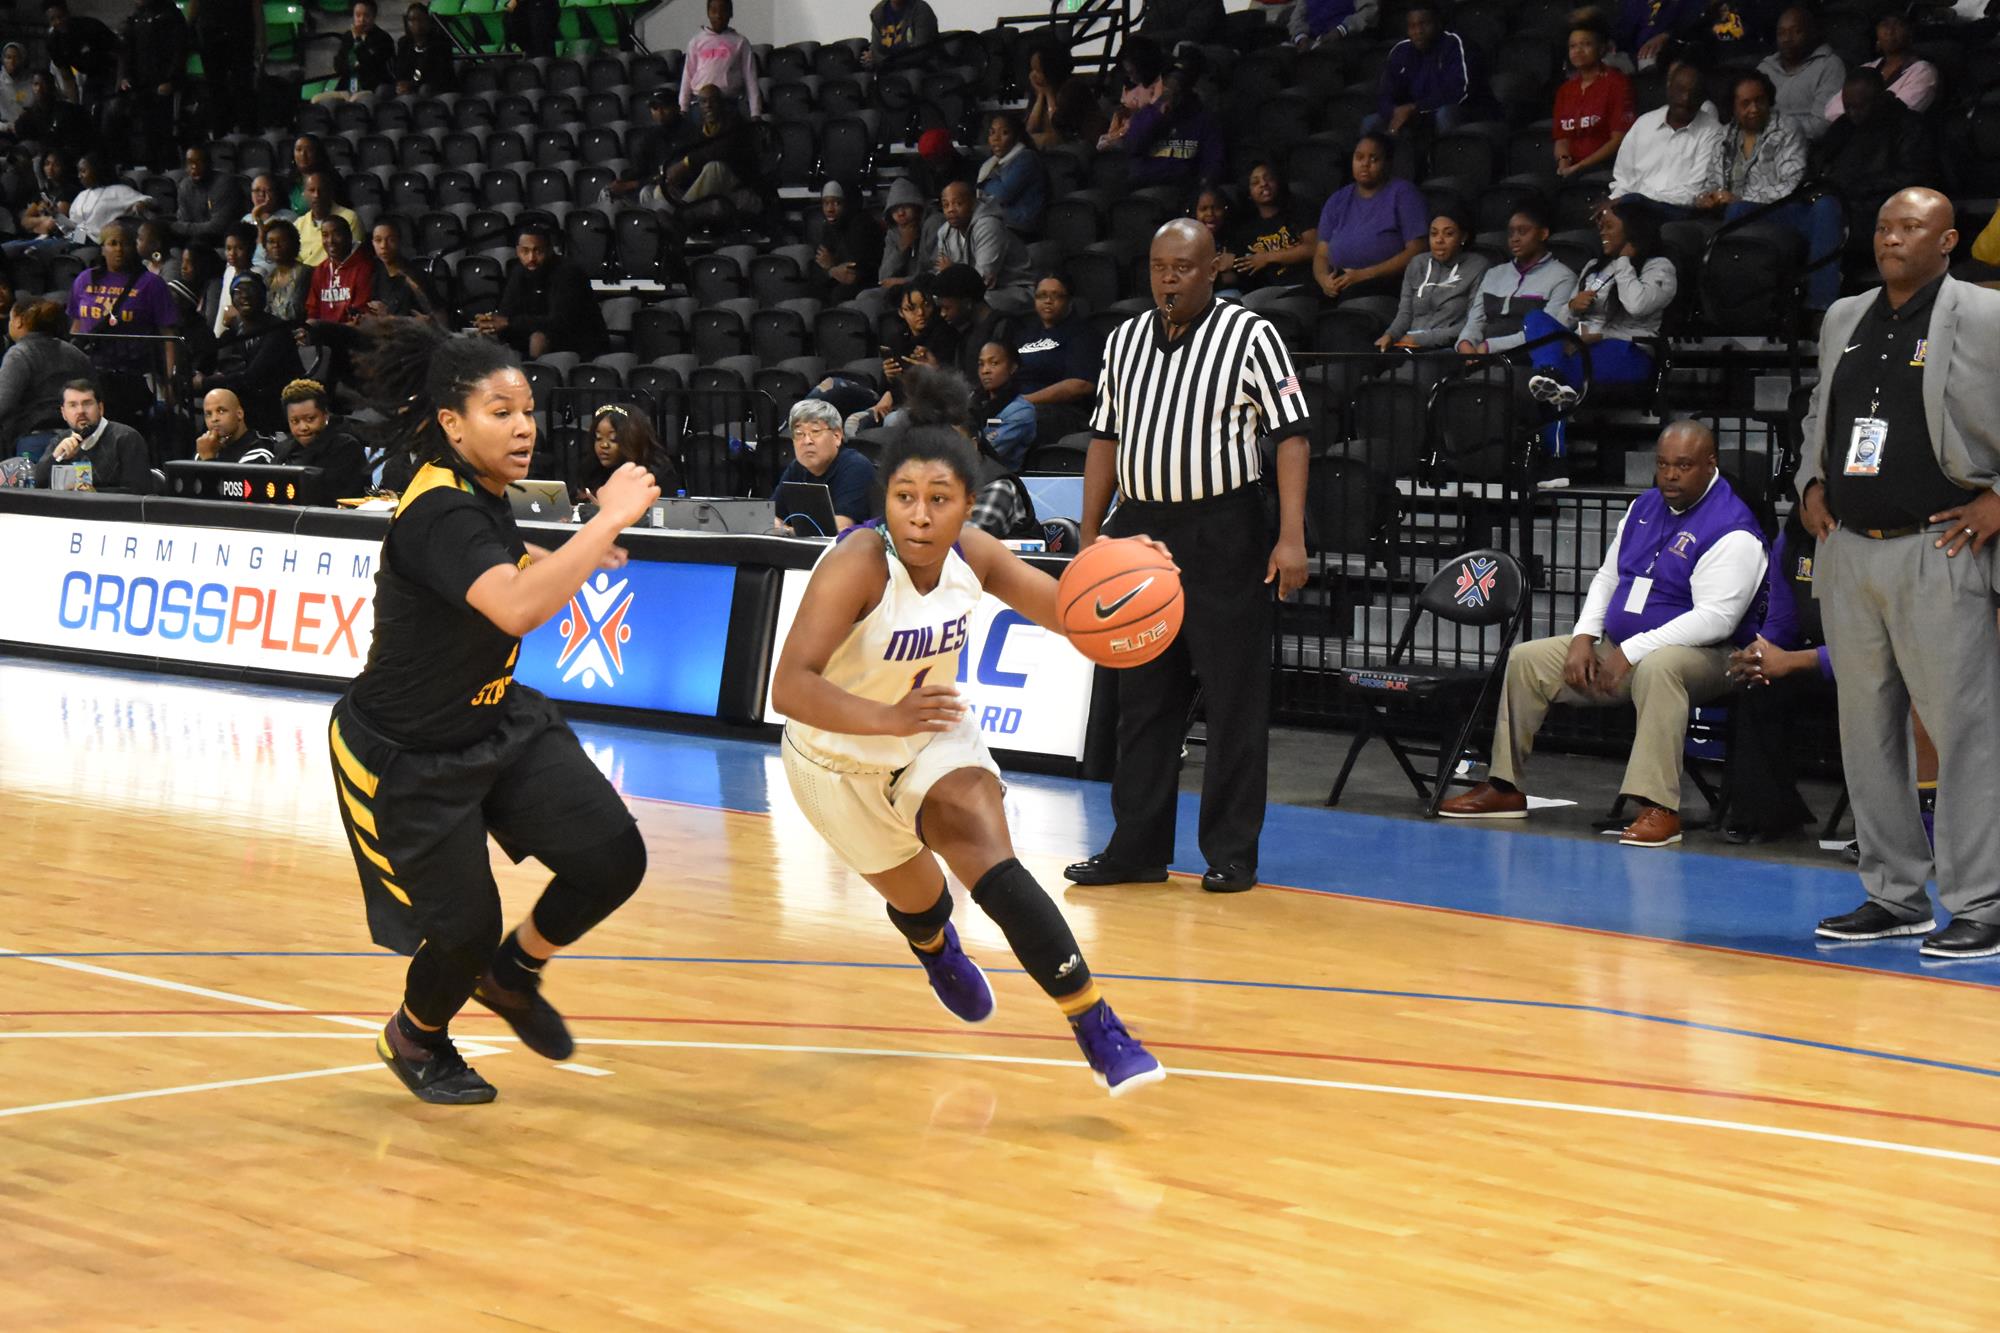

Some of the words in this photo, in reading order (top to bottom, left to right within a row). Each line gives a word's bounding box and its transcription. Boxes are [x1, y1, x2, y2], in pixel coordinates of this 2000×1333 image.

[223, 481, 243, 497] POSS
[69, 532, 371, 579] BIRMINGHAM
[58, 570, 367, 658] CROSSPLEX
[883, 614, 967, 661] MILES
[1110, 620, 1168, 655] ELITE
